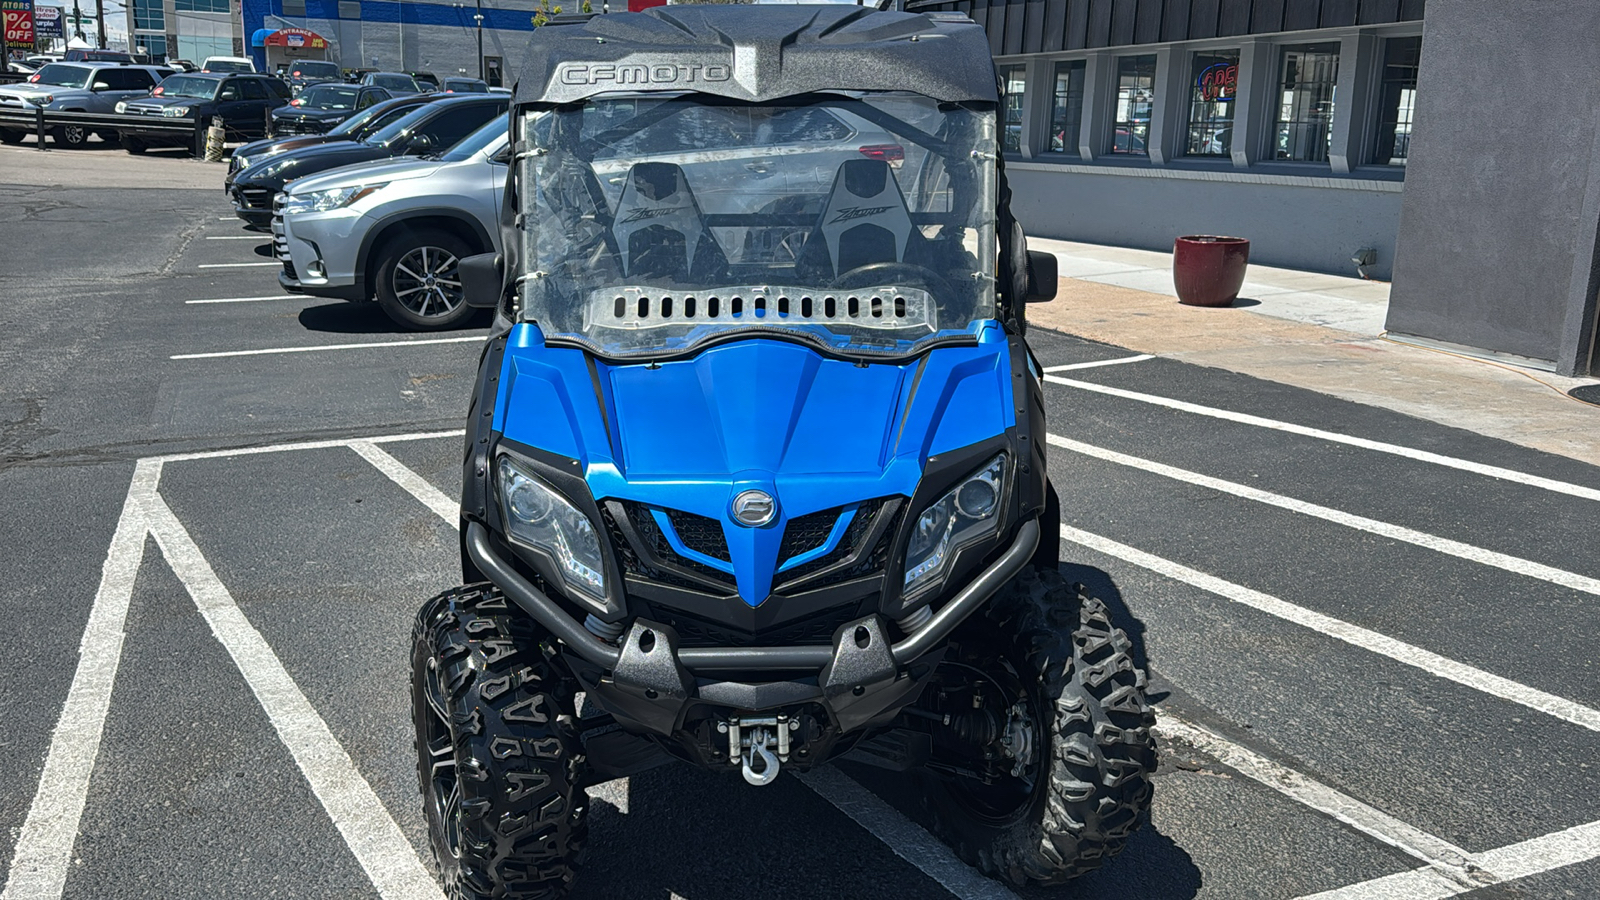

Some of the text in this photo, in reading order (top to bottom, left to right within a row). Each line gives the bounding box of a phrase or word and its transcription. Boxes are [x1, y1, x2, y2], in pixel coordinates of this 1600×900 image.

[7, 30, 32, 40] OFF
[279, 28, 312, 37] ENTRANCE
[5, 40, 34, 49] Delivery
[561, 64, 731, 85] CFMOTO
